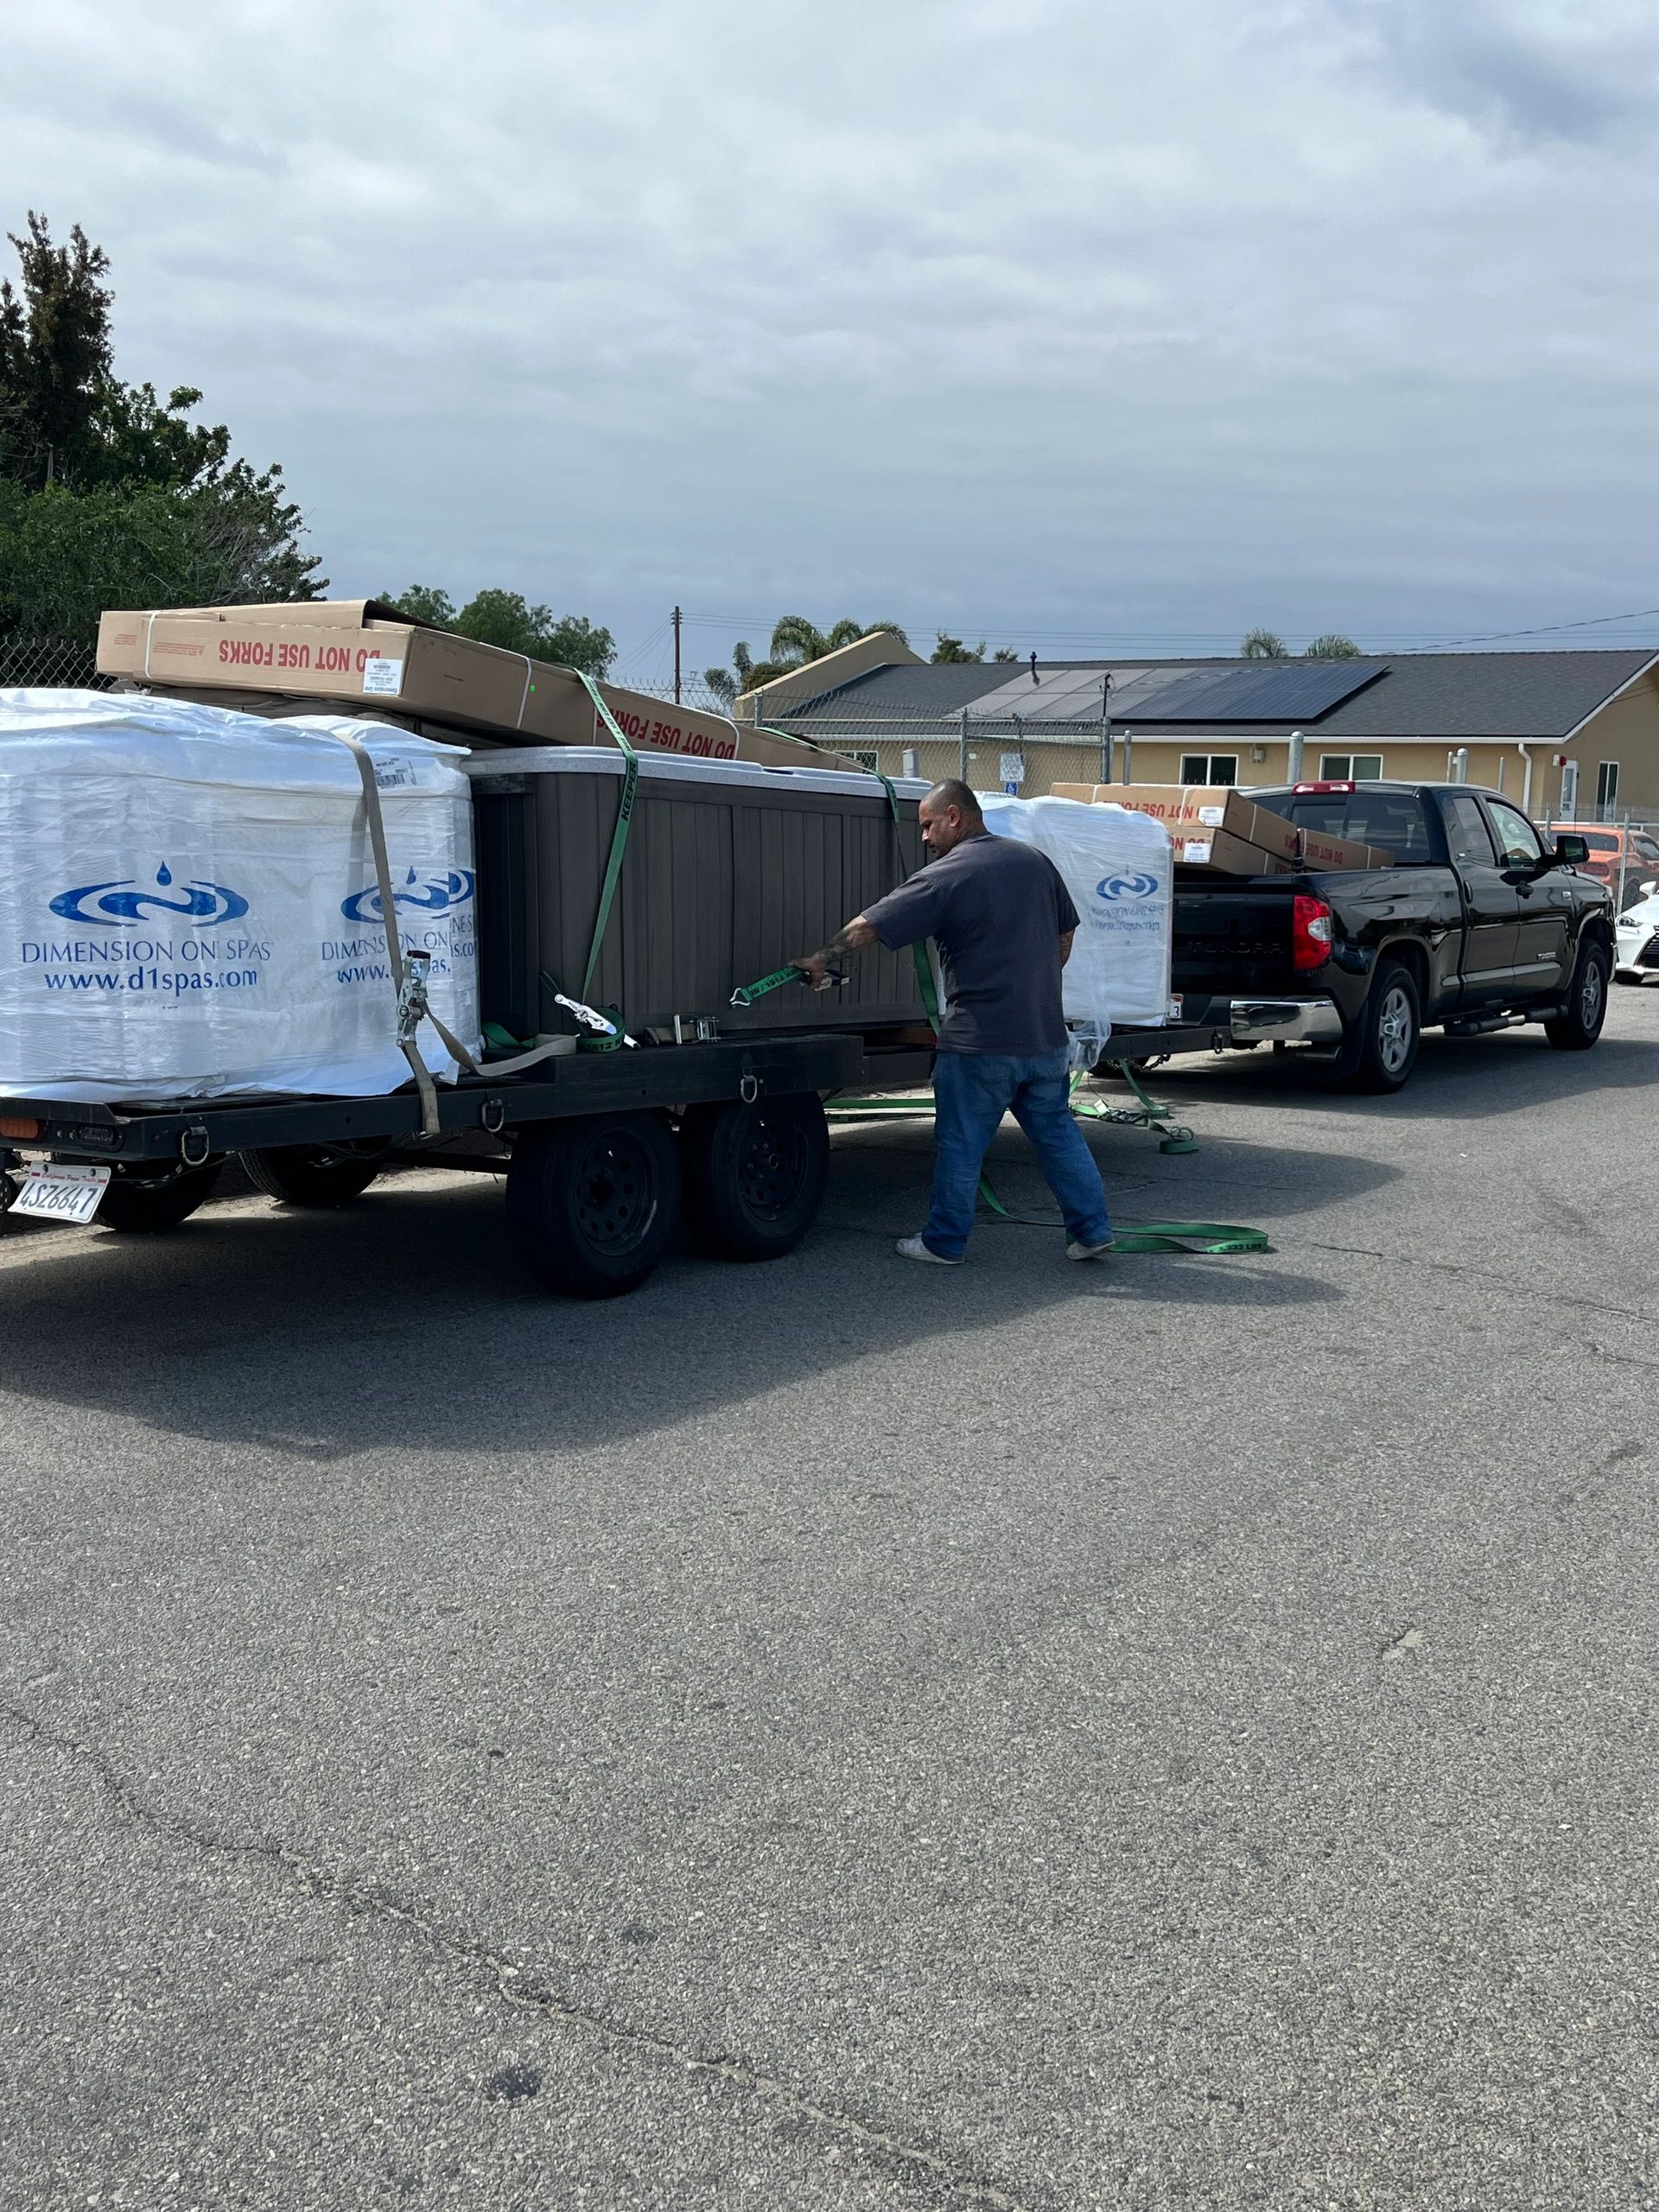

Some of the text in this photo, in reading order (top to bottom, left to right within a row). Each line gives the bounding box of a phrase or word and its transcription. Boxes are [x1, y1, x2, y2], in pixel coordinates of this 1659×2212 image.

[219, 639, 273, 666] FORKS
[278, 643, 310, 668] USE
[315, 646, 351, 671] NOT
[650, 721, 682, 749] USE
[682, 732, 714, 758] NOT
[715, 741, 736, 760] DO
[620, 761, 637, 823] KEEPER
[22, 939, 270, 963] DIMENSION ON SPAS
[43, 966, 257, 996] www.d1spas.com
[19, 1181, 99, 1214] 4SZ6647
